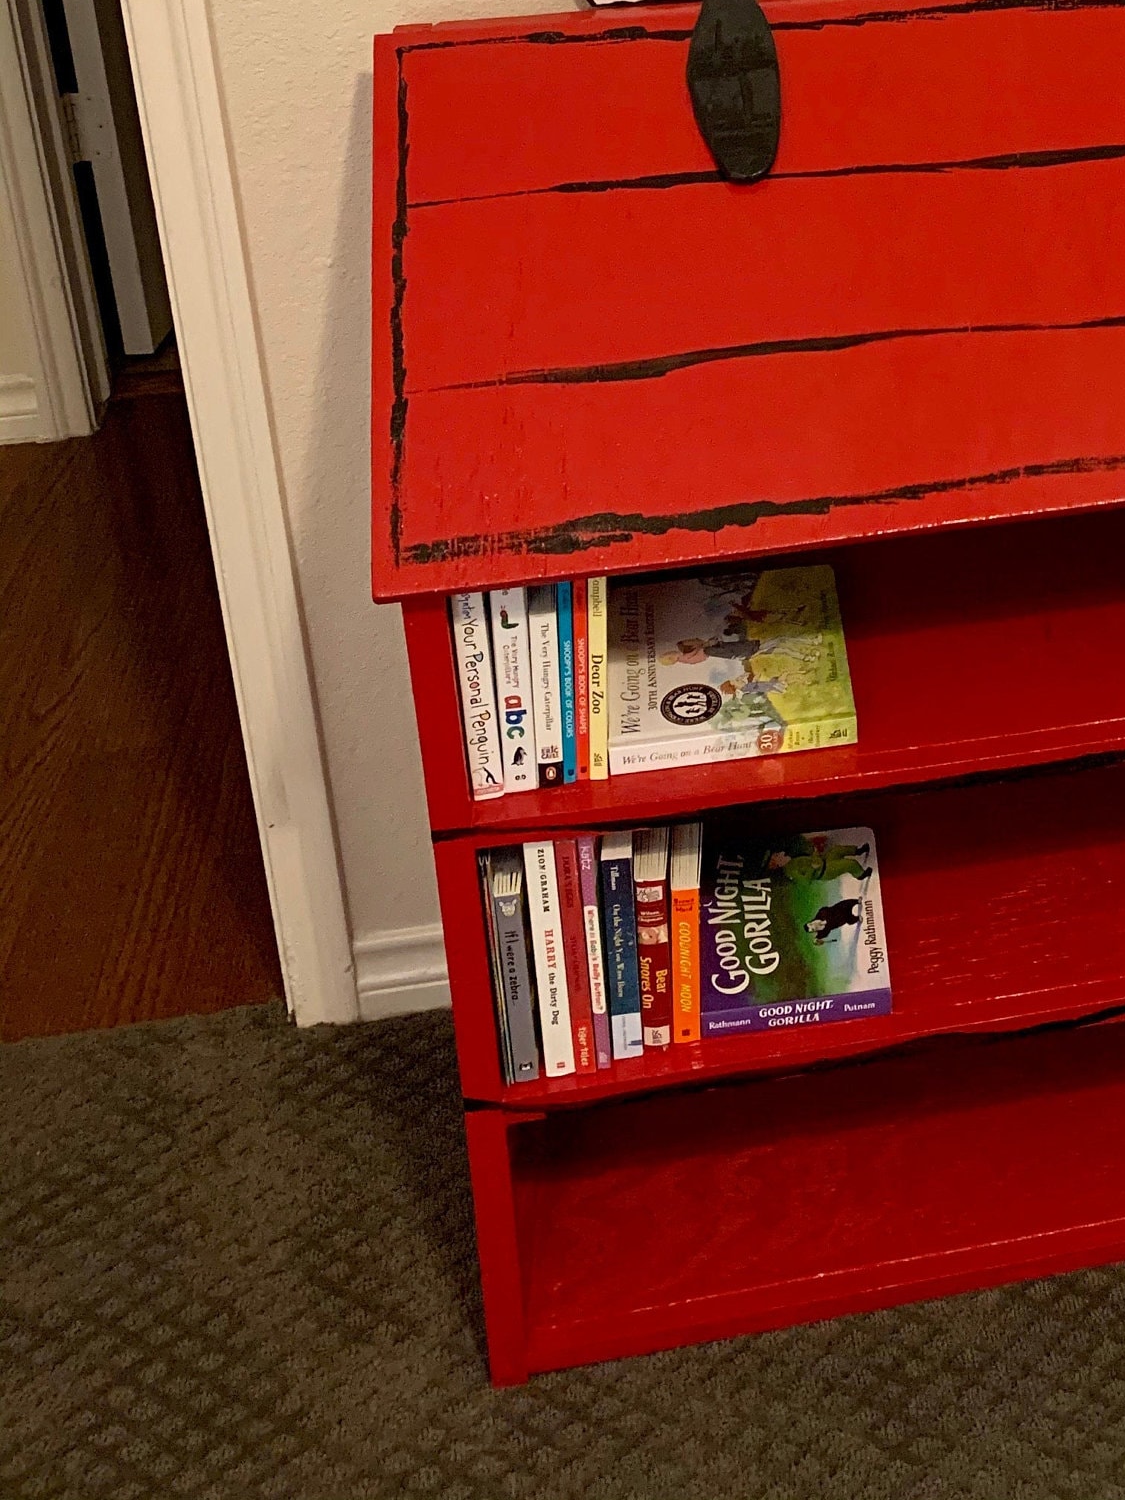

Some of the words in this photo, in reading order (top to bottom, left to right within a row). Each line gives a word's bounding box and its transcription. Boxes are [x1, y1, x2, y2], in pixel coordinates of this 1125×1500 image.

[590, 579, 603, 617] ampbell
[462, 619, 479, 650] Your
[541, 623, 550, 638] The
[540, 640, 550, 658] Very
[563, 640, 572, 676] SNOOPY'S
[577, 638, 586, 674] SNOOPY'S
[627, 652, 640, 668] on
[646, 637, 657, 687] ANNIVERSARY
[465, 651, 489, 709] Personal
[541, 661, 552, 689] Hungry
[591, 654, 604, 687] Dear
[564, 677, 573, 697] BOOK
[578, 675, 586, 695] BOOK
[620, 668, 646, 701] Going
[543, 691, 554, 731] Caterpillar
[565, 700, 573, 709] OF
[579, 697, 586, 706] OF
[592, 691, 604, 715] Zoo
[648, 690, 658, 711] 30TH
[504, 695, 527, 740] abc
[565, 710, 574, 738] COLORS
[579, 708, 587, 735] SHAPES
[620, 702, 641, 735] We're
[469, 709, 494, 766] Penguin
[761, 735, 773, 750] 30
[622, 754, 646, 765] We're
[649, 752, 678, 762] Going
[703, 744, 725, 755] Bear
[728, 741, 752, 751] Hunt
[610, 865, 620, 891] Tillman
[504, 930, 519, 938] If
[741, 877, 780, 975] GORILLA
[864, 900, 877, 946] Rathmann
[505, 944, 515, 967] were
[545, 928, 557, 969] HARRY
[679, 922, 692, 980] GOODNIGHT
[867, 947, 885, 974] Peggy
[640, 956, 653, 991] Snores
[711, 930, 750, 995] GOOD
[548, 973, 557, 985] the
[655, 969, 668, 993] Bear
[549, 987, 558, 1008] Dirty
[642, 994, 654, 1009] On
[680, 984, 692, 1013] MOON
[759, 1004, 792, 1018] GOOD
[551, 1010, 560, 1026] Dog
[709, 1018, 751, 1030] Rathmann
[844, 1002, 876, 1012] Putnam
[768, 1013, 820, 1027] GORILLA
[578, 1027, 587, 1047] tiger
[579, 1047, 589, 1066] tales
